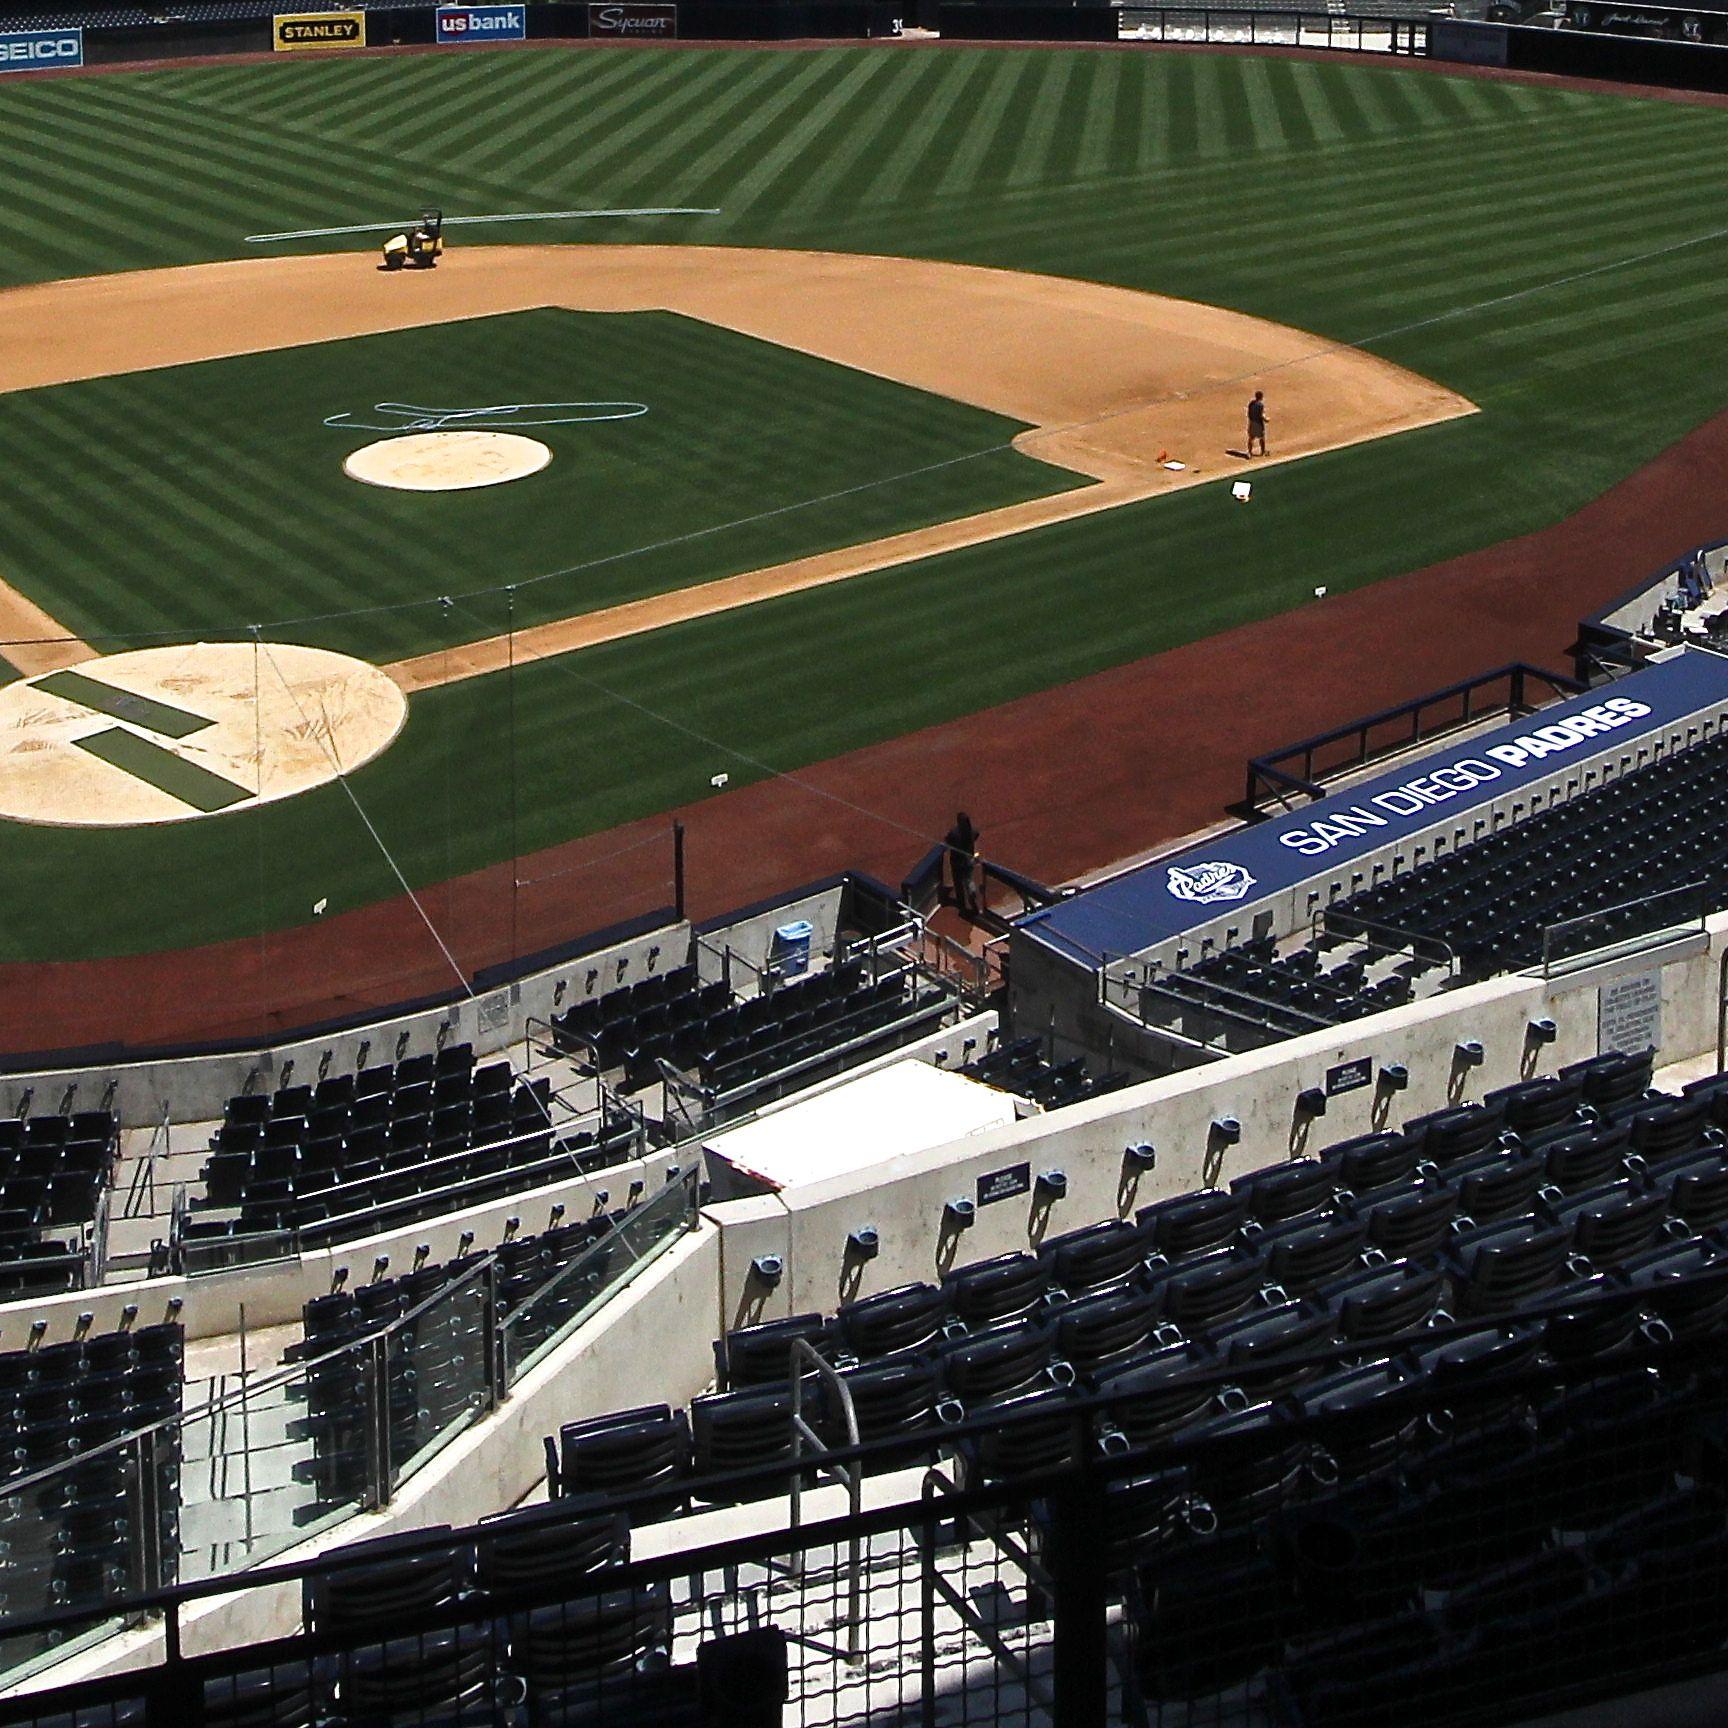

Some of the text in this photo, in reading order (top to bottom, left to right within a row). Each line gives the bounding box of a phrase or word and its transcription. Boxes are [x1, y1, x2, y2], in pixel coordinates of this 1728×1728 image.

[284, 23, 354, 39] STANLEY
[598, 9, 672, 34] Sycuan
[1279, 697, 1652, 855] SAN DIEGO PADRES
